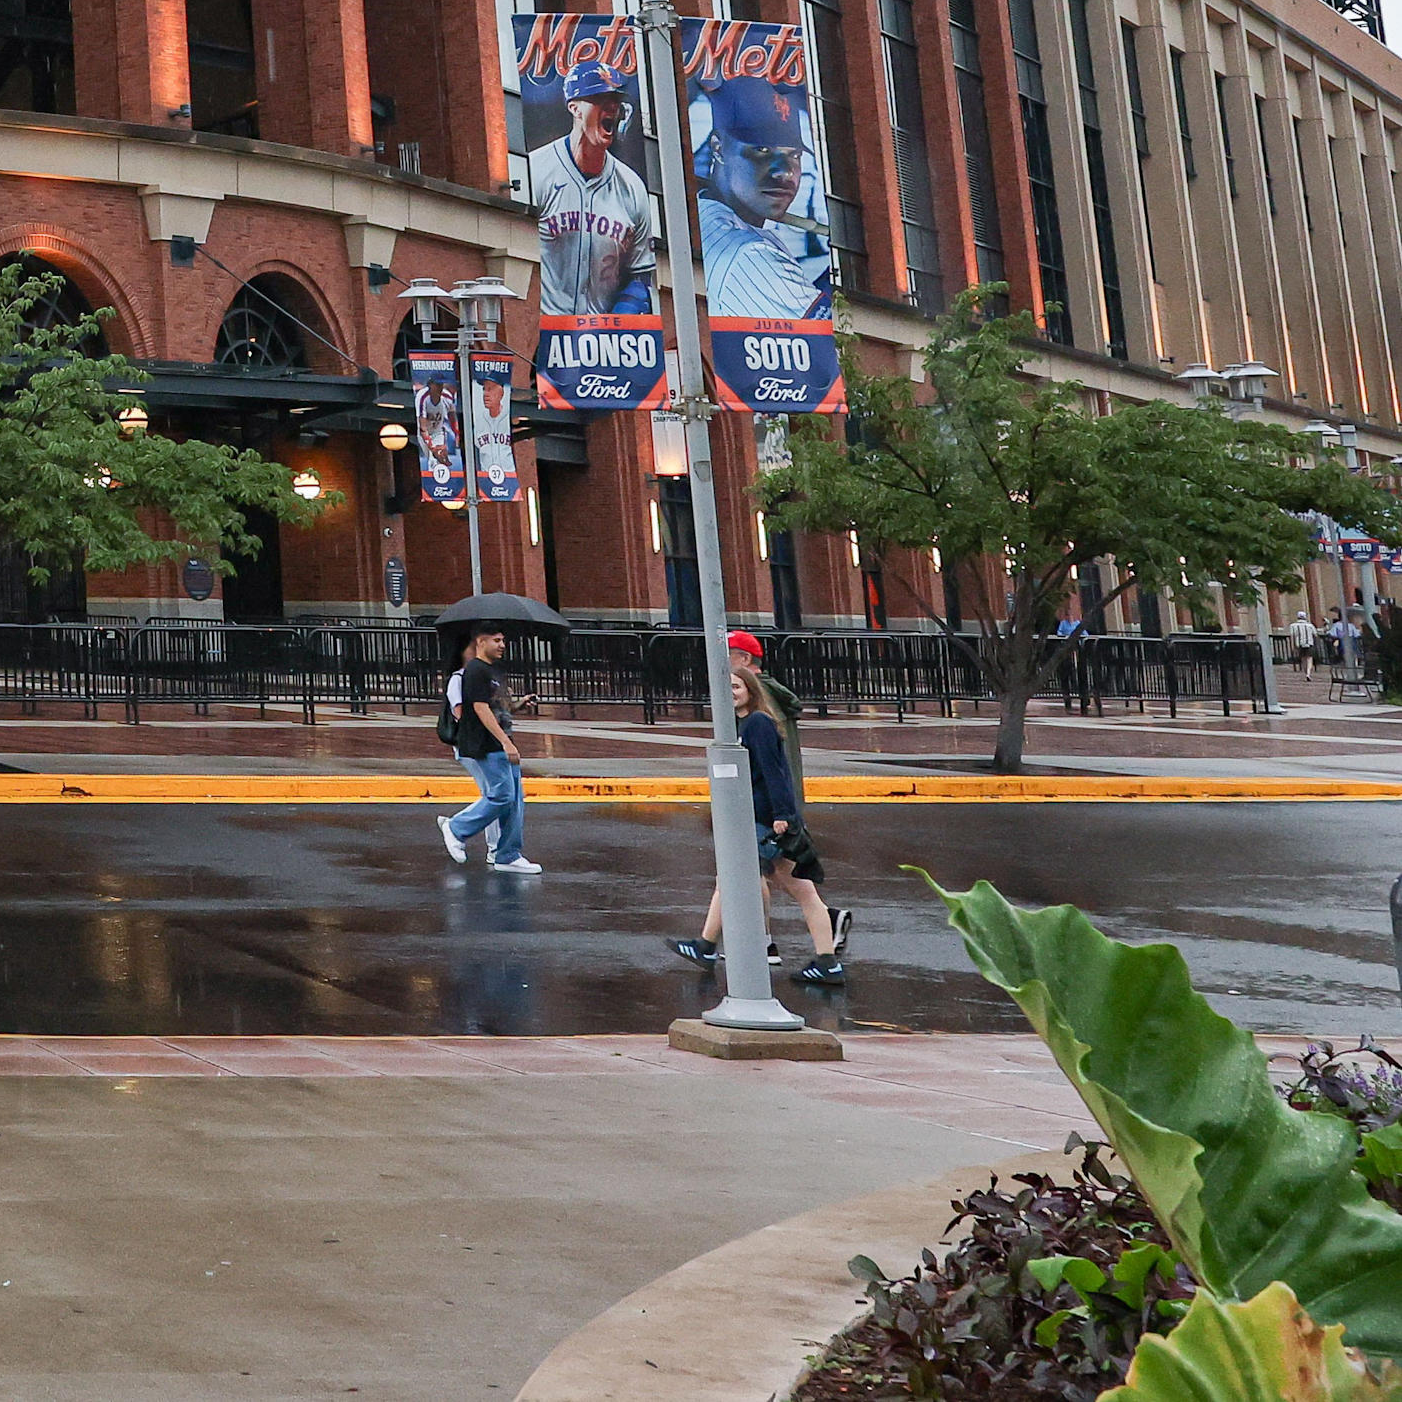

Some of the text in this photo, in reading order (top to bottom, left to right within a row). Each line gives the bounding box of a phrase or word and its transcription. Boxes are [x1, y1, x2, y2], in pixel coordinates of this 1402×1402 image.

[517, 14, 638, 77] Mets
[683, 19, 805, 86] Mets
[547, 211, 580, 237] NEW
[576, 317, 622, 328] PETE
[754, 320, 793, 331] JUAN
[547, 333, 658, 369] ALONSO
[744, 336, 812, 372] SOTO
[412, 360, 455, 371] HERNANDEZ
[475, 360, 510, 373] STENGEL
[576, 374, 631, 399] Ford
[754, 377, 807, 402] Ford
[477, 433, 512, 448] EW YOR
[437, 468, 445, 480] 17
[491, 469, 501, 481] 37
[433, 486, 453, 497] Ford
[490, 486, 509, 497] Ford
